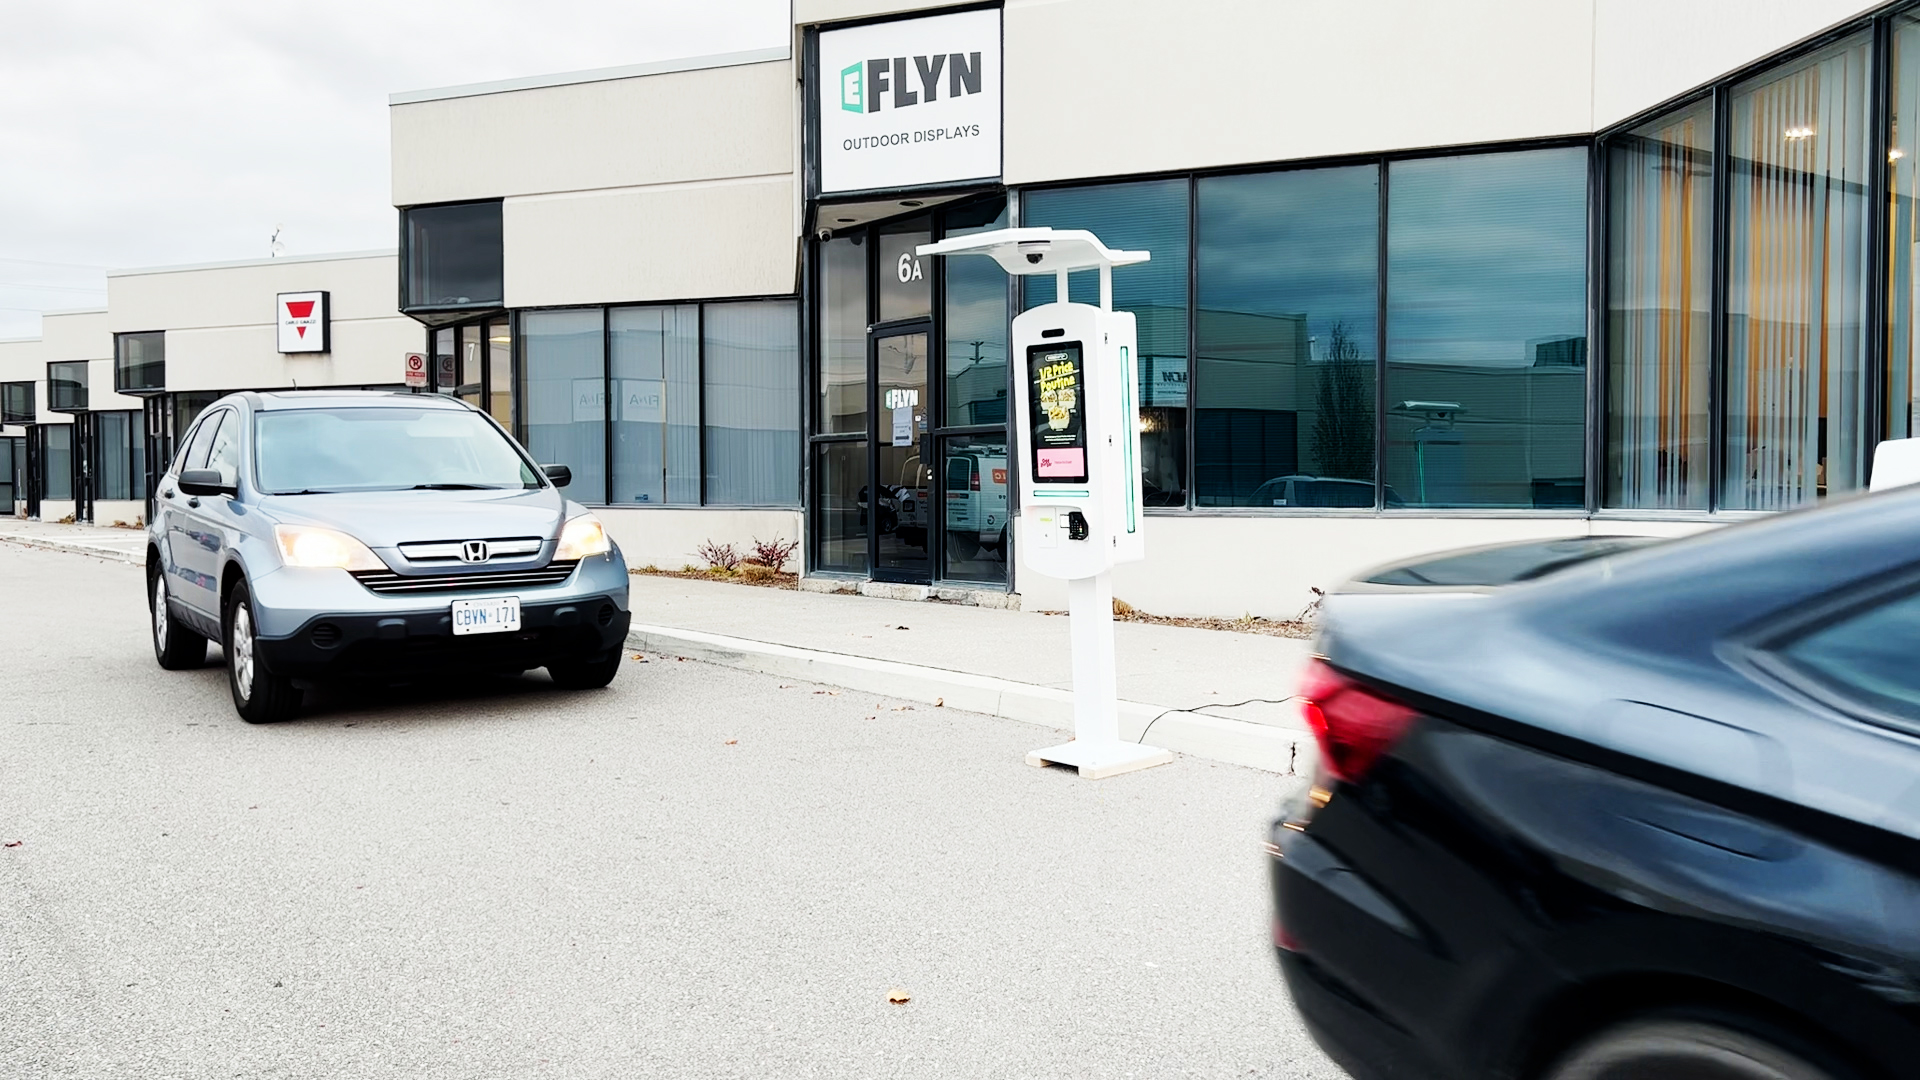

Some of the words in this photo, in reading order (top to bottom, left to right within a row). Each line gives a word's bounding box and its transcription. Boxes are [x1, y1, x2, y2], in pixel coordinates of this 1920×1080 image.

[843, 133, 910, 151] OUTDOOR
[914, 125, 980, 143] DISPLAYS
[898, 252, 923, 283] 6A
[468, 342, 476, 362] 7
[1052, 361, 1074, 376] Price
[1040, 375, 1076, 393] Poutine
[456, 608, 487, 626] CBVN
[496, 606, 516, 623] 171
